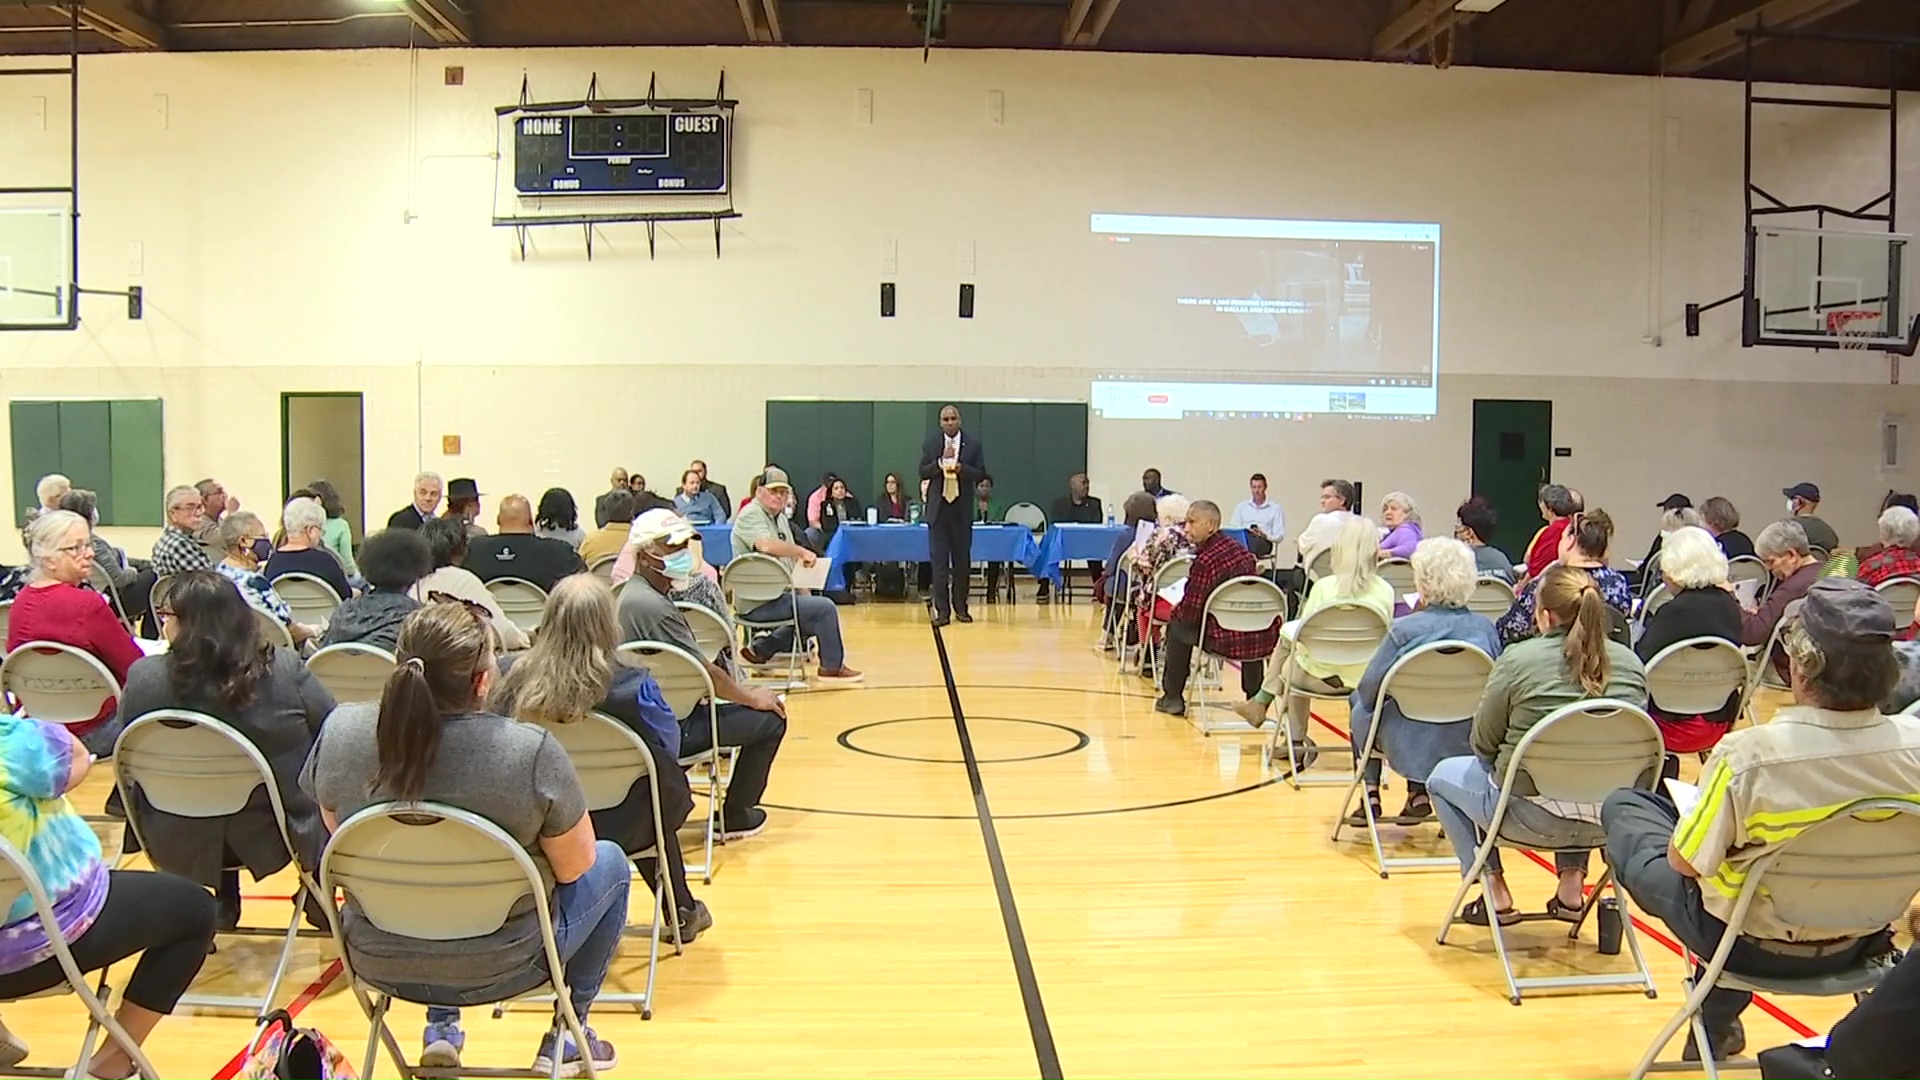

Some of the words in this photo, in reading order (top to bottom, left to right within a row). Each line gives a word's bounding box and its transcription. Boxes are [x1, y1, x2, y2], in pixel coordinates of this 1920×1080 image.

[523, 119, 563, 135] HOME
[674, 117, 719, 132] GUEST
[552, 179, 580, 189] BONUS
[657, 178, 685, 188] BONUS
